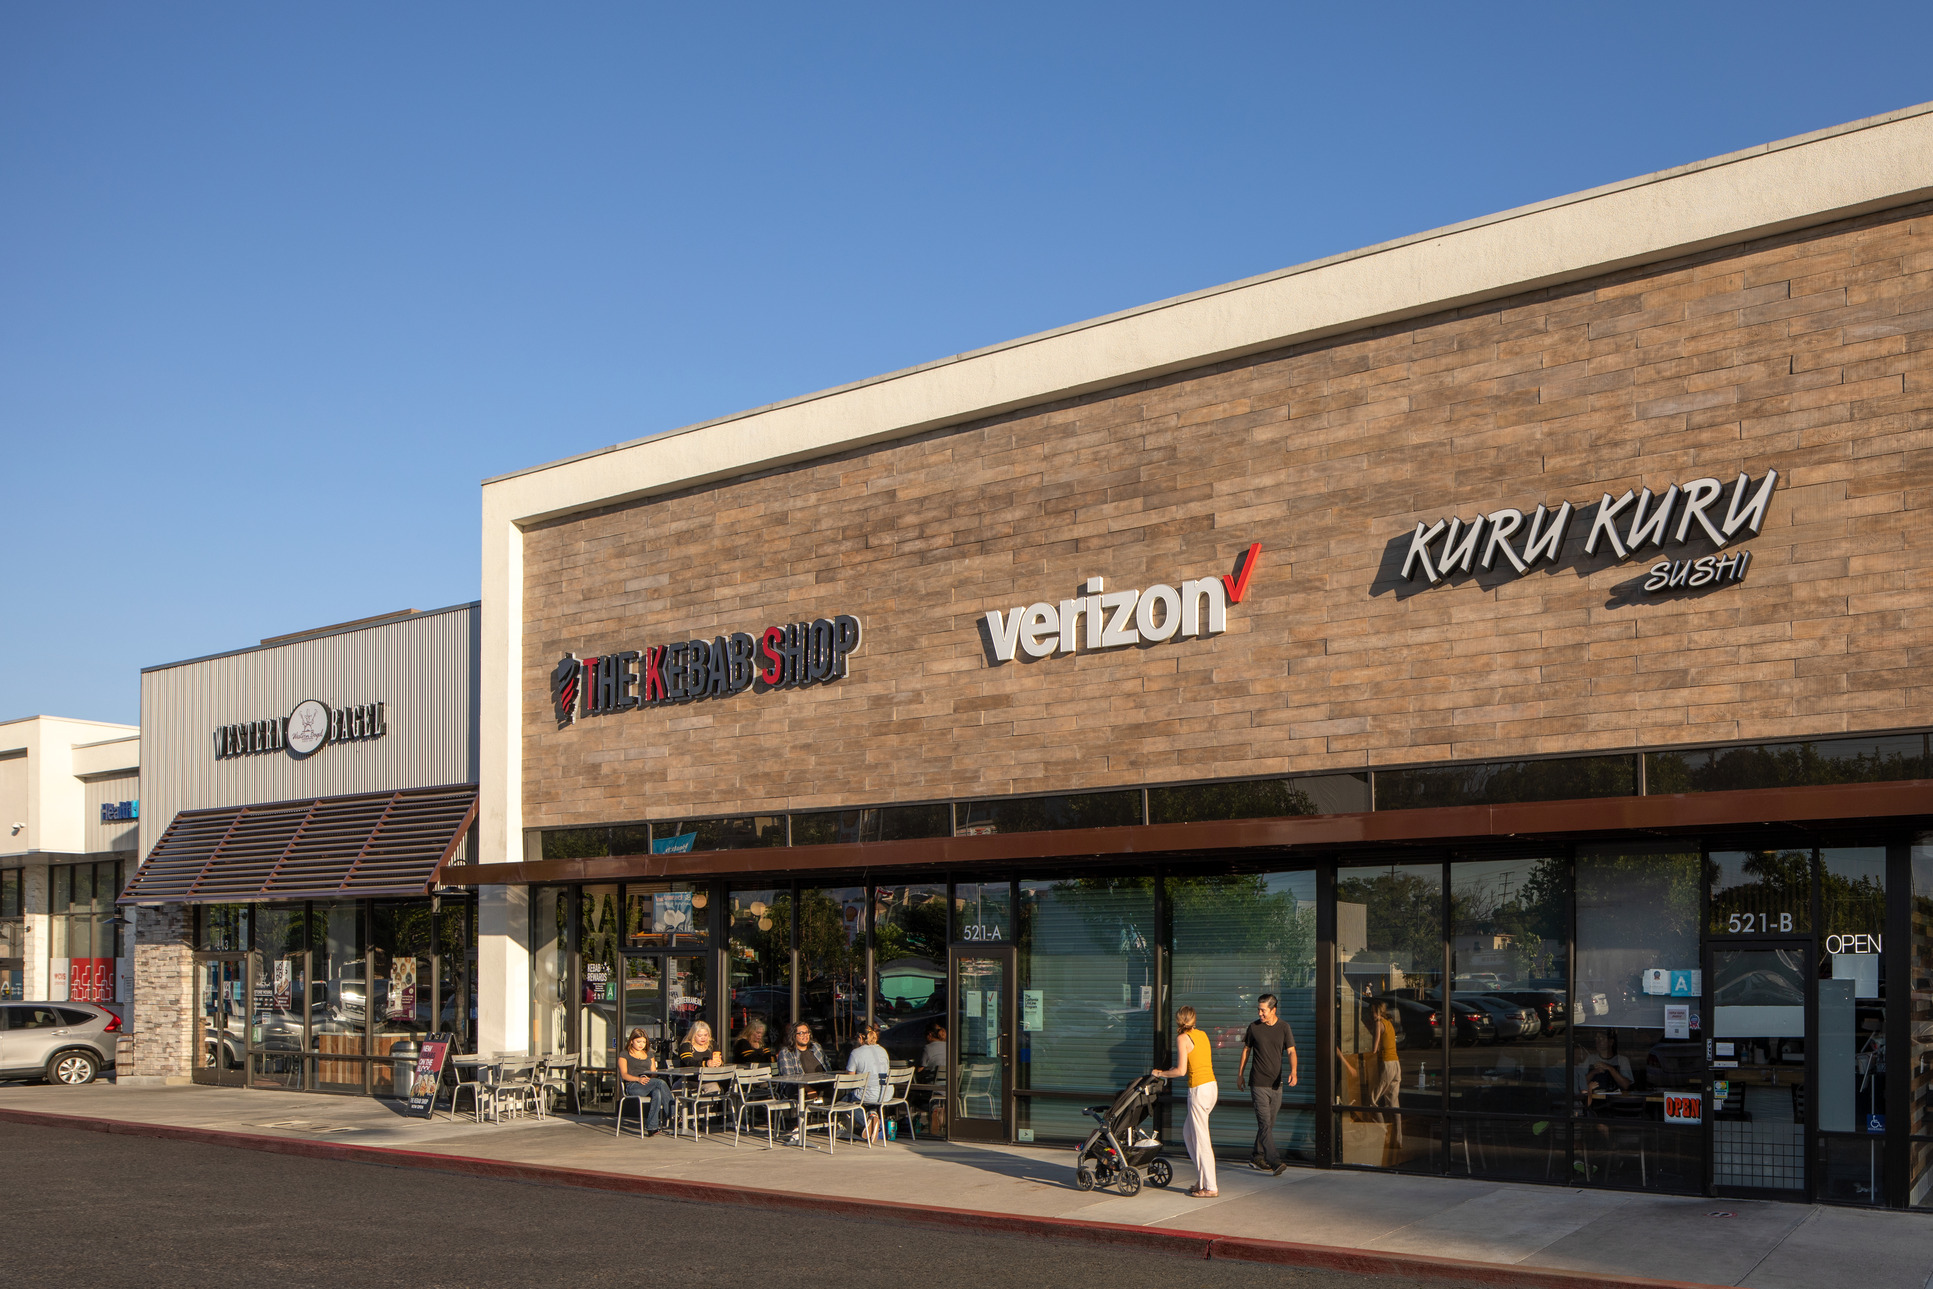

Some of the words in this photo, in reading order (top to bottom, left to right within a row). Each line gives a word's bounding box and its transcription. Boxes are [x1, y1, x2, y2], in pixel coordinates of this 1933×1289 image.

[1400, 500, 1577, 586] KURU
[1585, 467, 1780, 561] KURU
[1643, 550, 1753, 593] SUSHI
[986, 575, 1227, 661] verizon
[583, 651, 642, 712] THE
[645, 632, 756, 703] KEBAB
[761, 615, 862, 688] SHOP
[214, 716, 284, 756] WESTERN
[330, 701, 386, 742] BAGEL
[963, 925, 1002, 940] 521-A
[1728, 912, 1793, 933] 521-B
[1825, 934, 1882, 954] OPEN
[1675, 975, 1688, 992] A
[1666, 1097, 1701, 1118] OPEN
